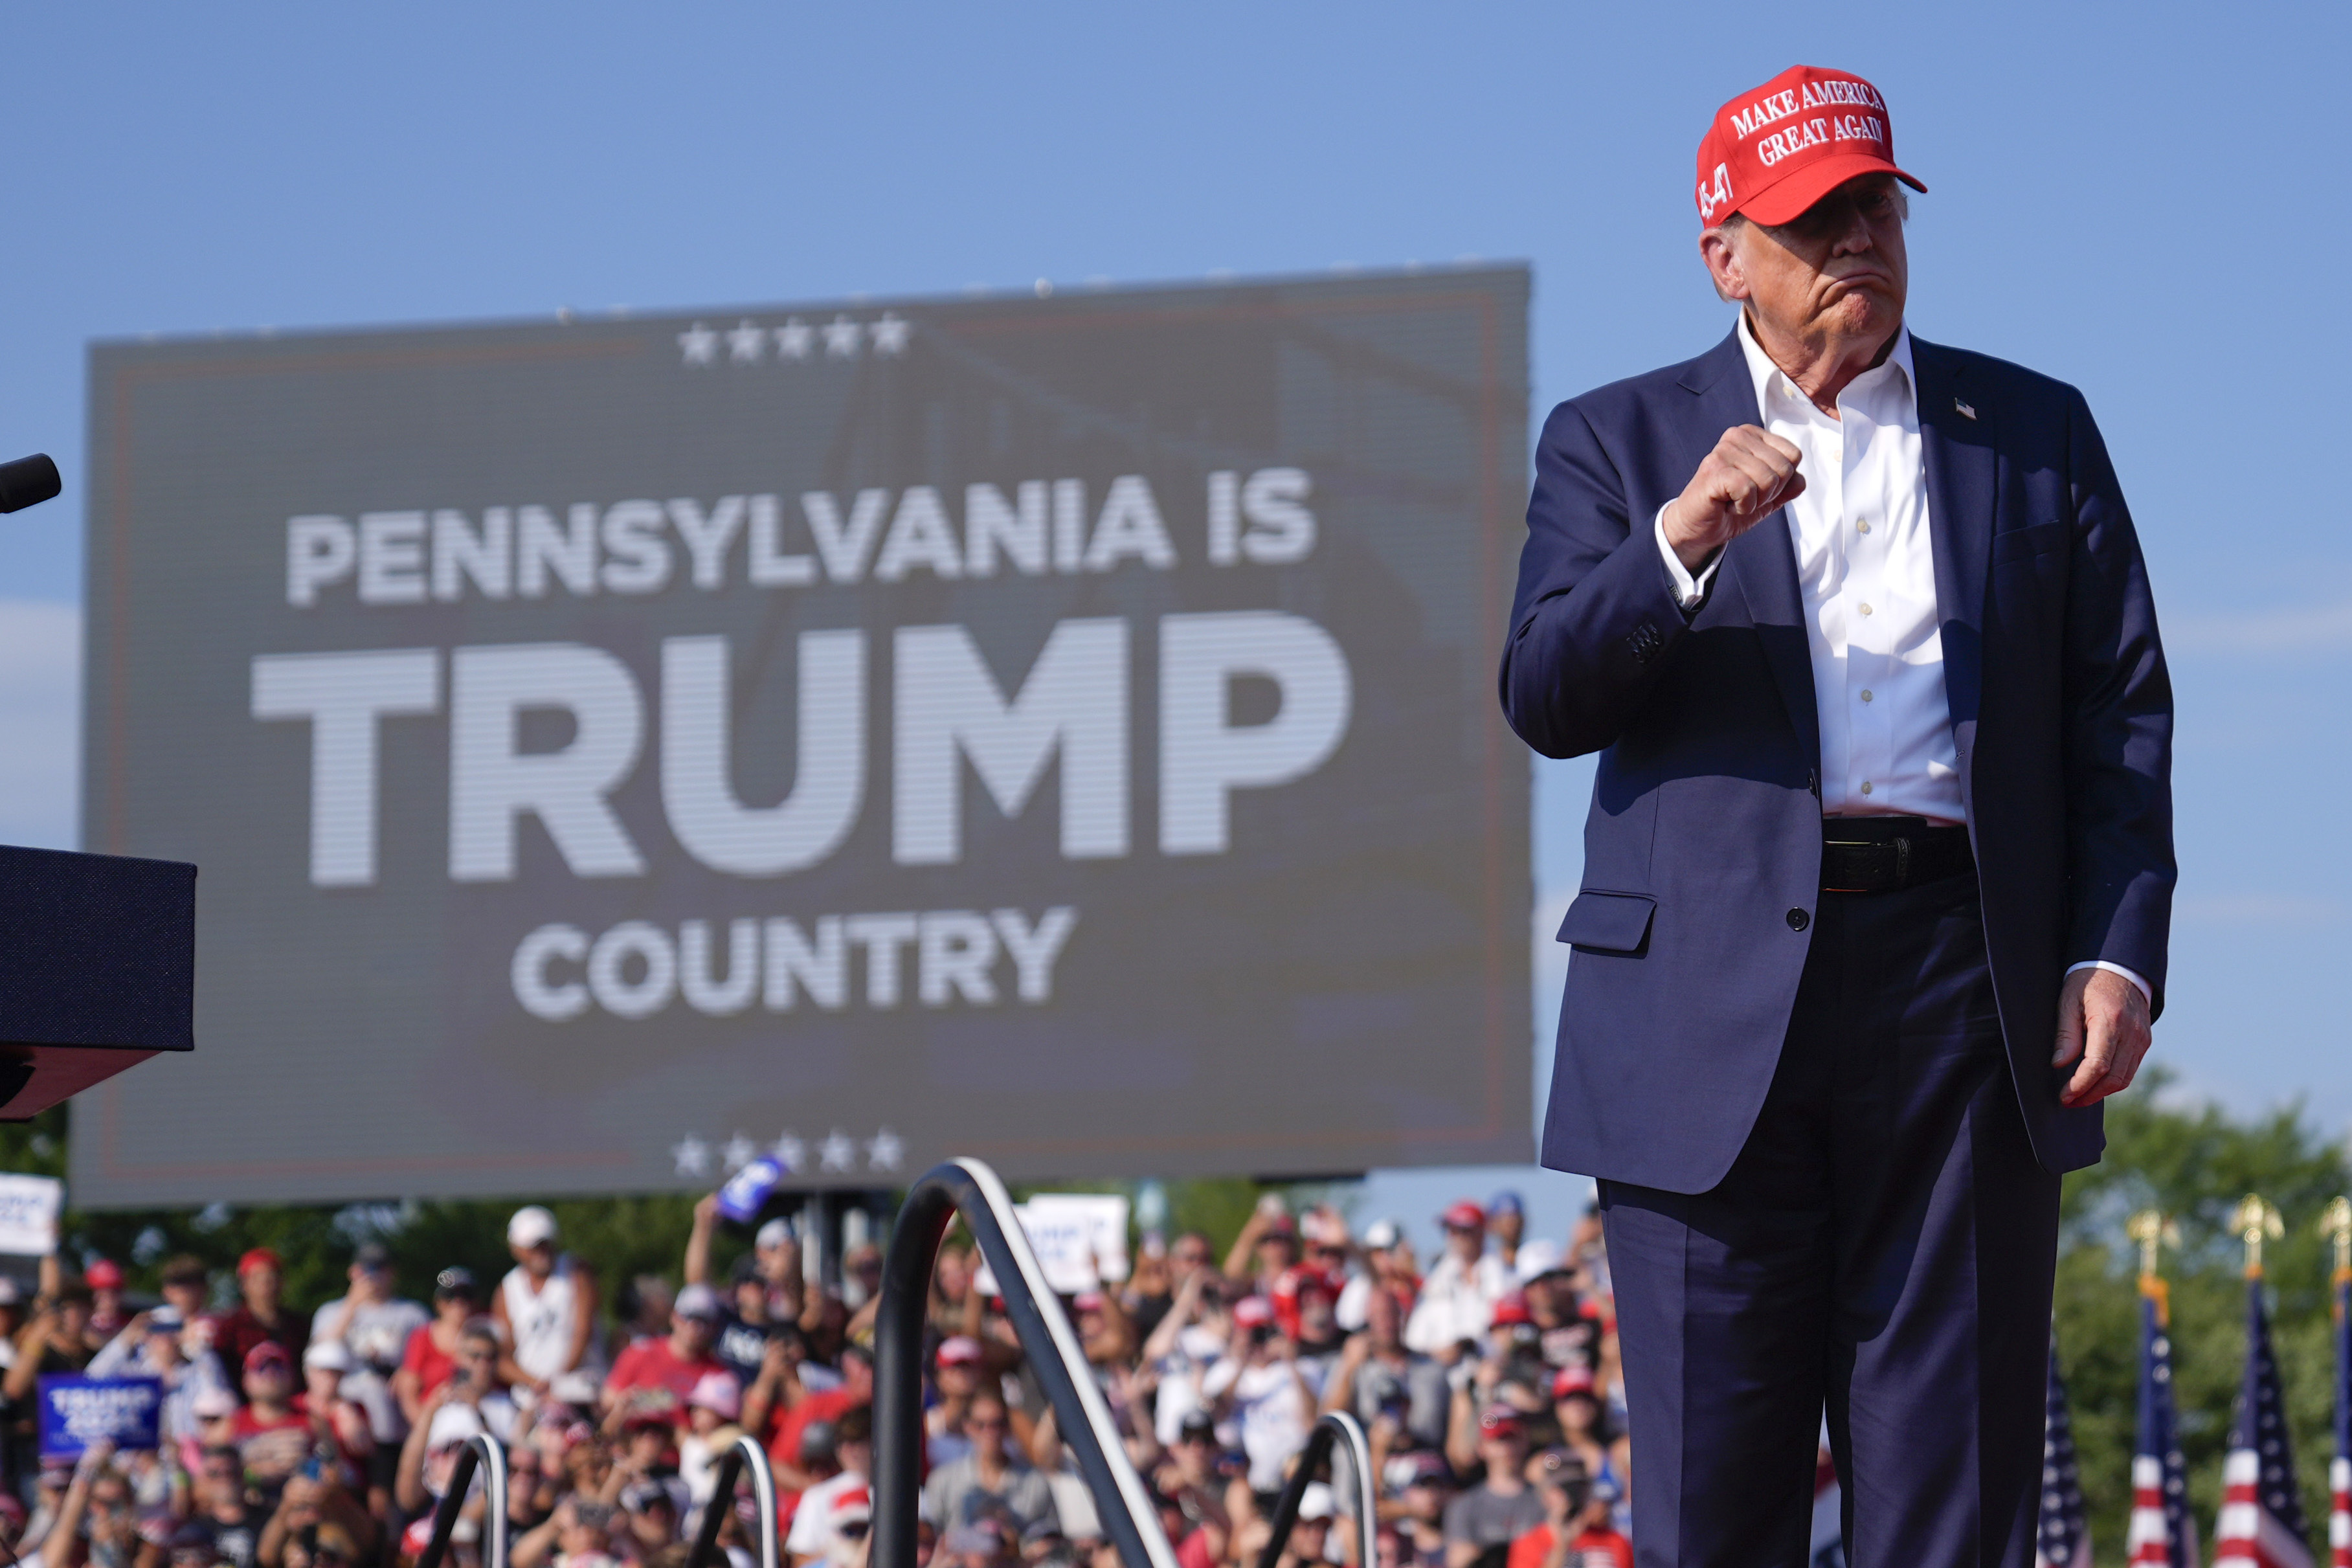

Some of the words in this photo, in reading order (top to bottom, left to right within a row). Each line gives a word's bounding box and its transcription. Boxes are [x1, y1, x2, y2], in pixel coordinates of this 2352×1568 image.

[1730, 89, 1800, 140] MAKE
[1802, 80, 1885, 111] AMERICA
[1758, 118, 1830, 167] GREAT
[1833, 114, 1883, 146] AGAIN
[286, 474, 1174, 607] PENNSYLVANIA
[1207, 467, 1318, 566] IS
[251, 610, 1354, 888] TRUMP
[510, 905, 1079, 1022] COUNTRY
